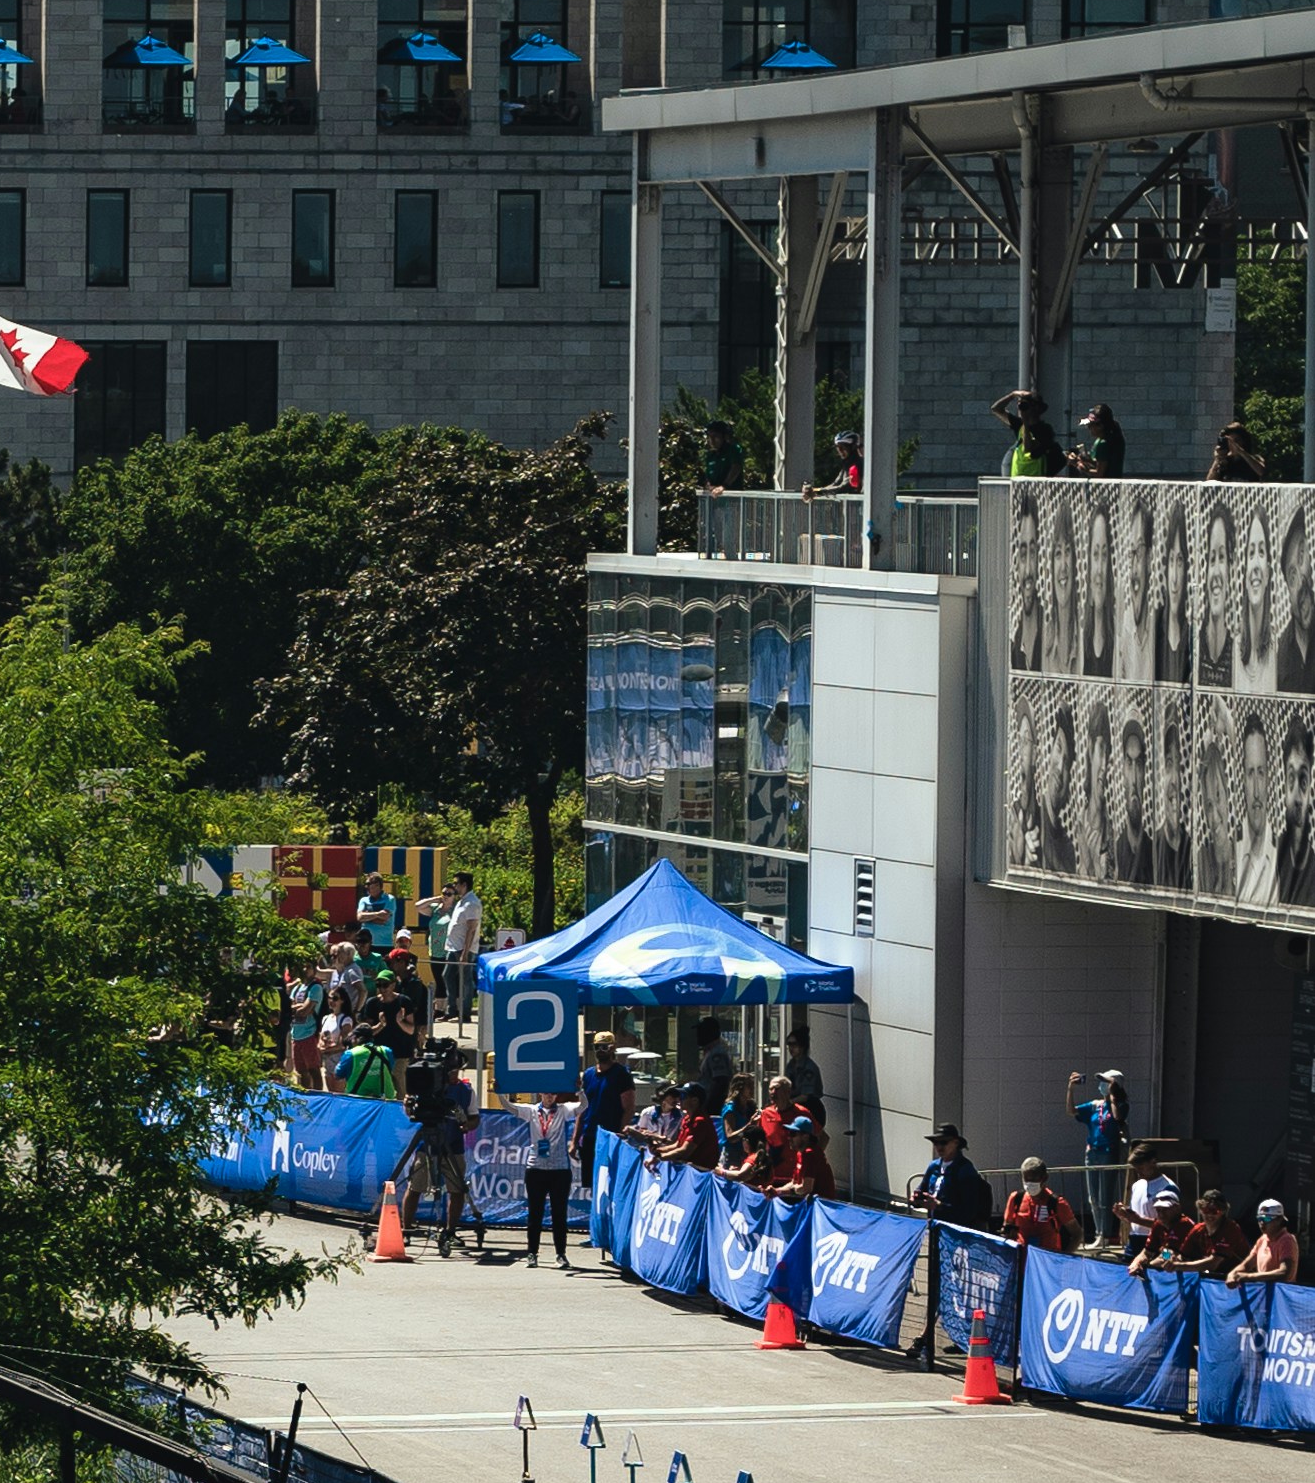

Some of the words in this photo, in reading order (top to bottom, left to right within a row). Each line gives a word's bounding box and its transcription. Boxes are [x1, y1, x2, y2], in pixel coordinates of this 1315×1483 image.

[507, 991, 565, 1071] 2
[292, 1141, 341, 1181] Copley
[649, 1201, 686, 1246] NTT
[829, 1248, 880, 1293] NTT
[1081, 1308, 1149, 1357] NTT
